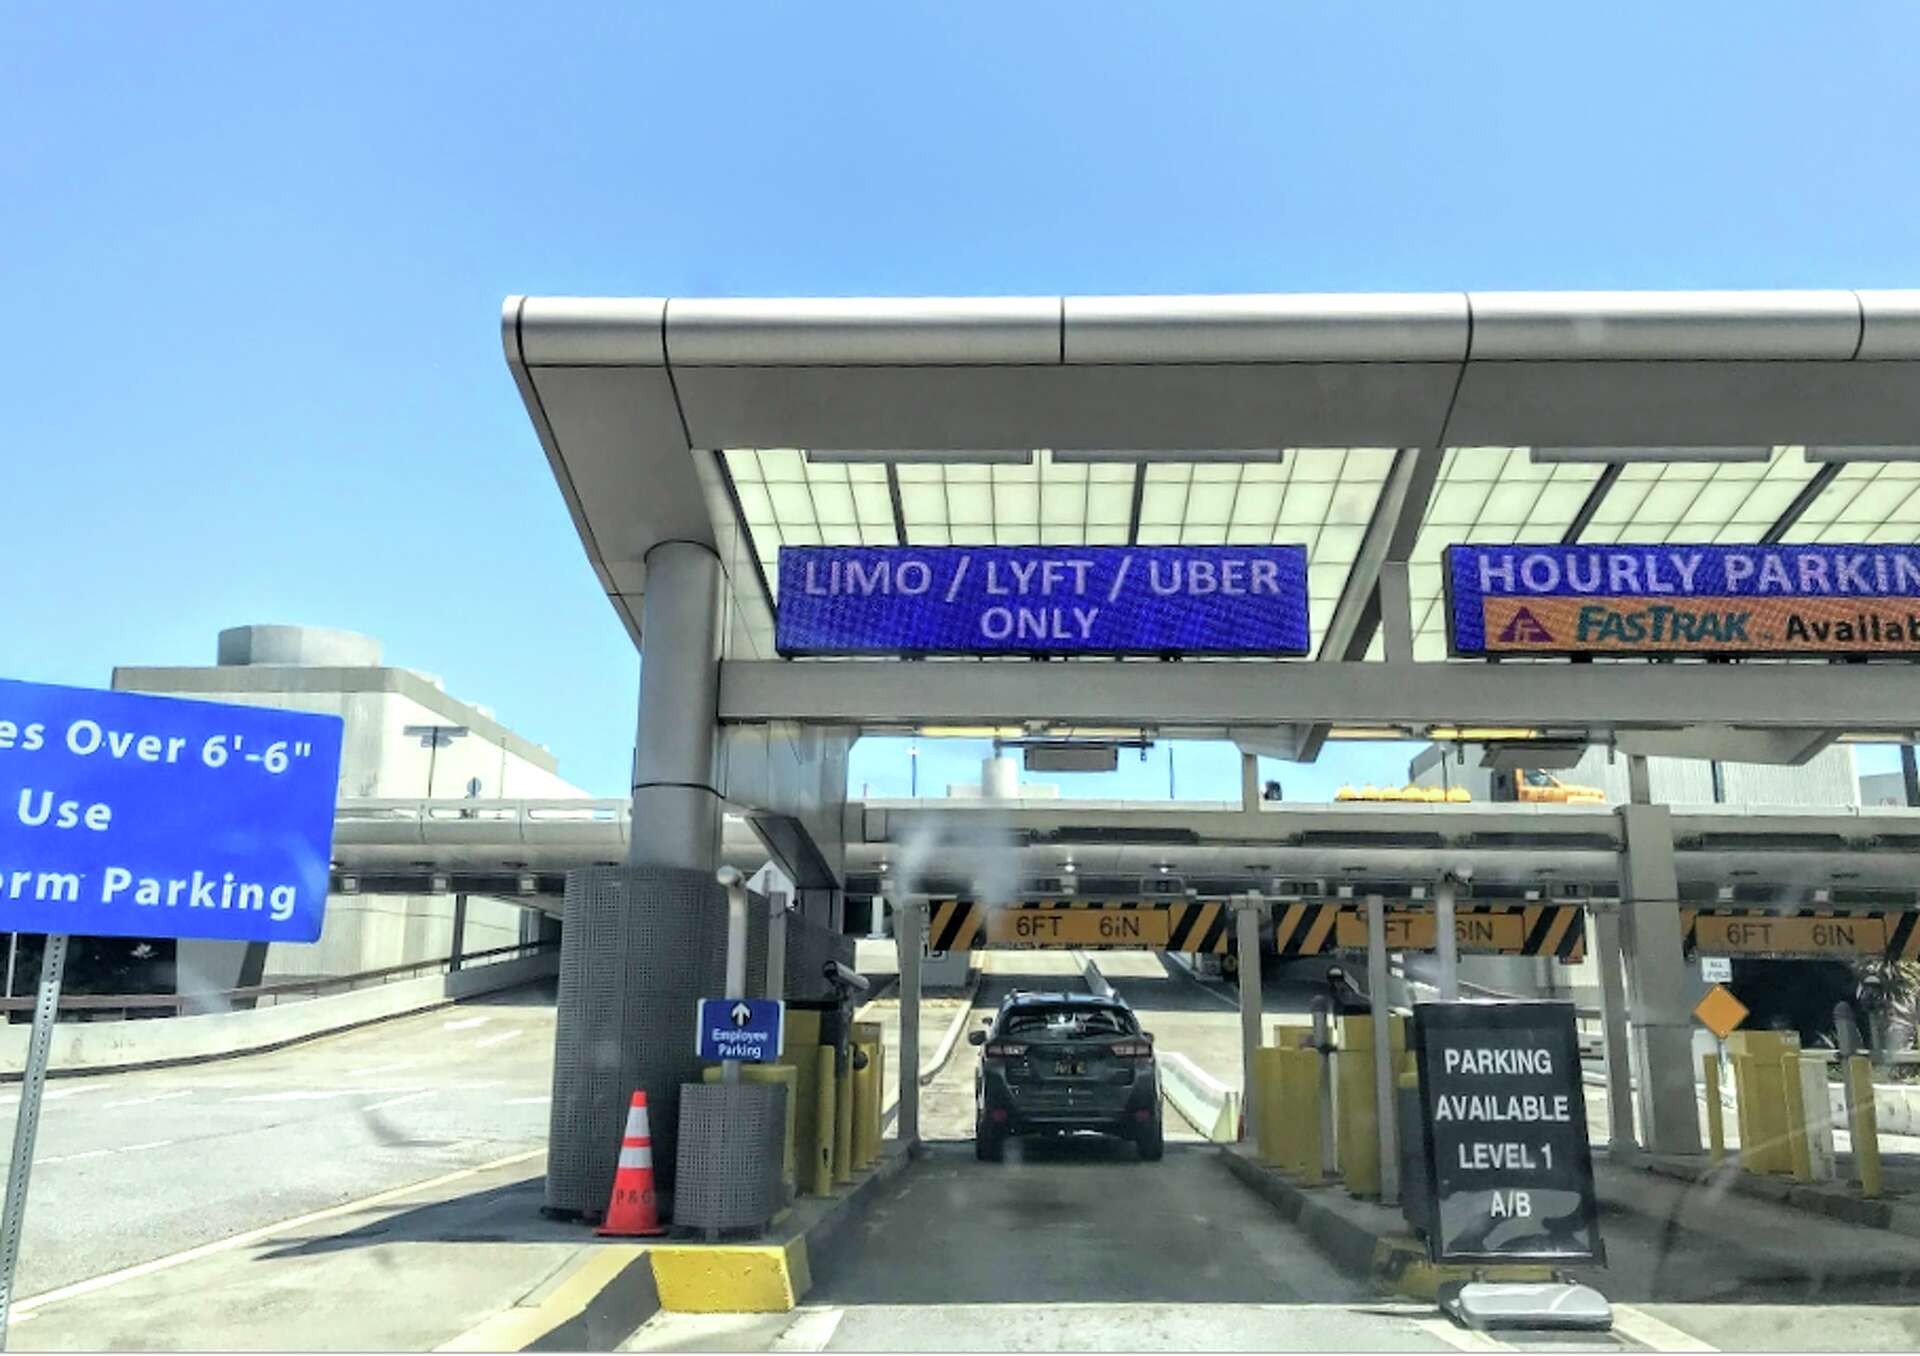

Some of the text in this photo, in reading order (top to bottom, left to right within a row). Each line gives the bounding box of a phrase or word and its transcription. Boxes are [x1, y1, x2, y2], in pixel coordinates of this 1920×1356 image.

[804, 558, 932, 596] LIMO
[986, 560, 1095, 596] LYFT
[1150, 559, 1281, 595] UBER
[1478, 553, 1704, 593] HOURLY
[981, 606, 1099, 640] ONLY
[66, 719, 186, 763] Over
[18, 788, 112, 831] Use
[0, 867, 297, 922] rm Parking
[1016, 916, 1063, 937] 6FT
[1384, 919, 1414, 940] FT
[1727, 923, 1855, 946] 6FT 6IN
[711, 1028, 768, 1043] Employee
[718, 1043, 761, 1059] Parking
[1444, 1049, 1553, 1075] PARKING
[1435, 1095, 1571, 1122] AVAILABLE
[1458, 1143, 1553, 1169] LEVEL 1
[1490, 1191, 1532, 1217] A/B
